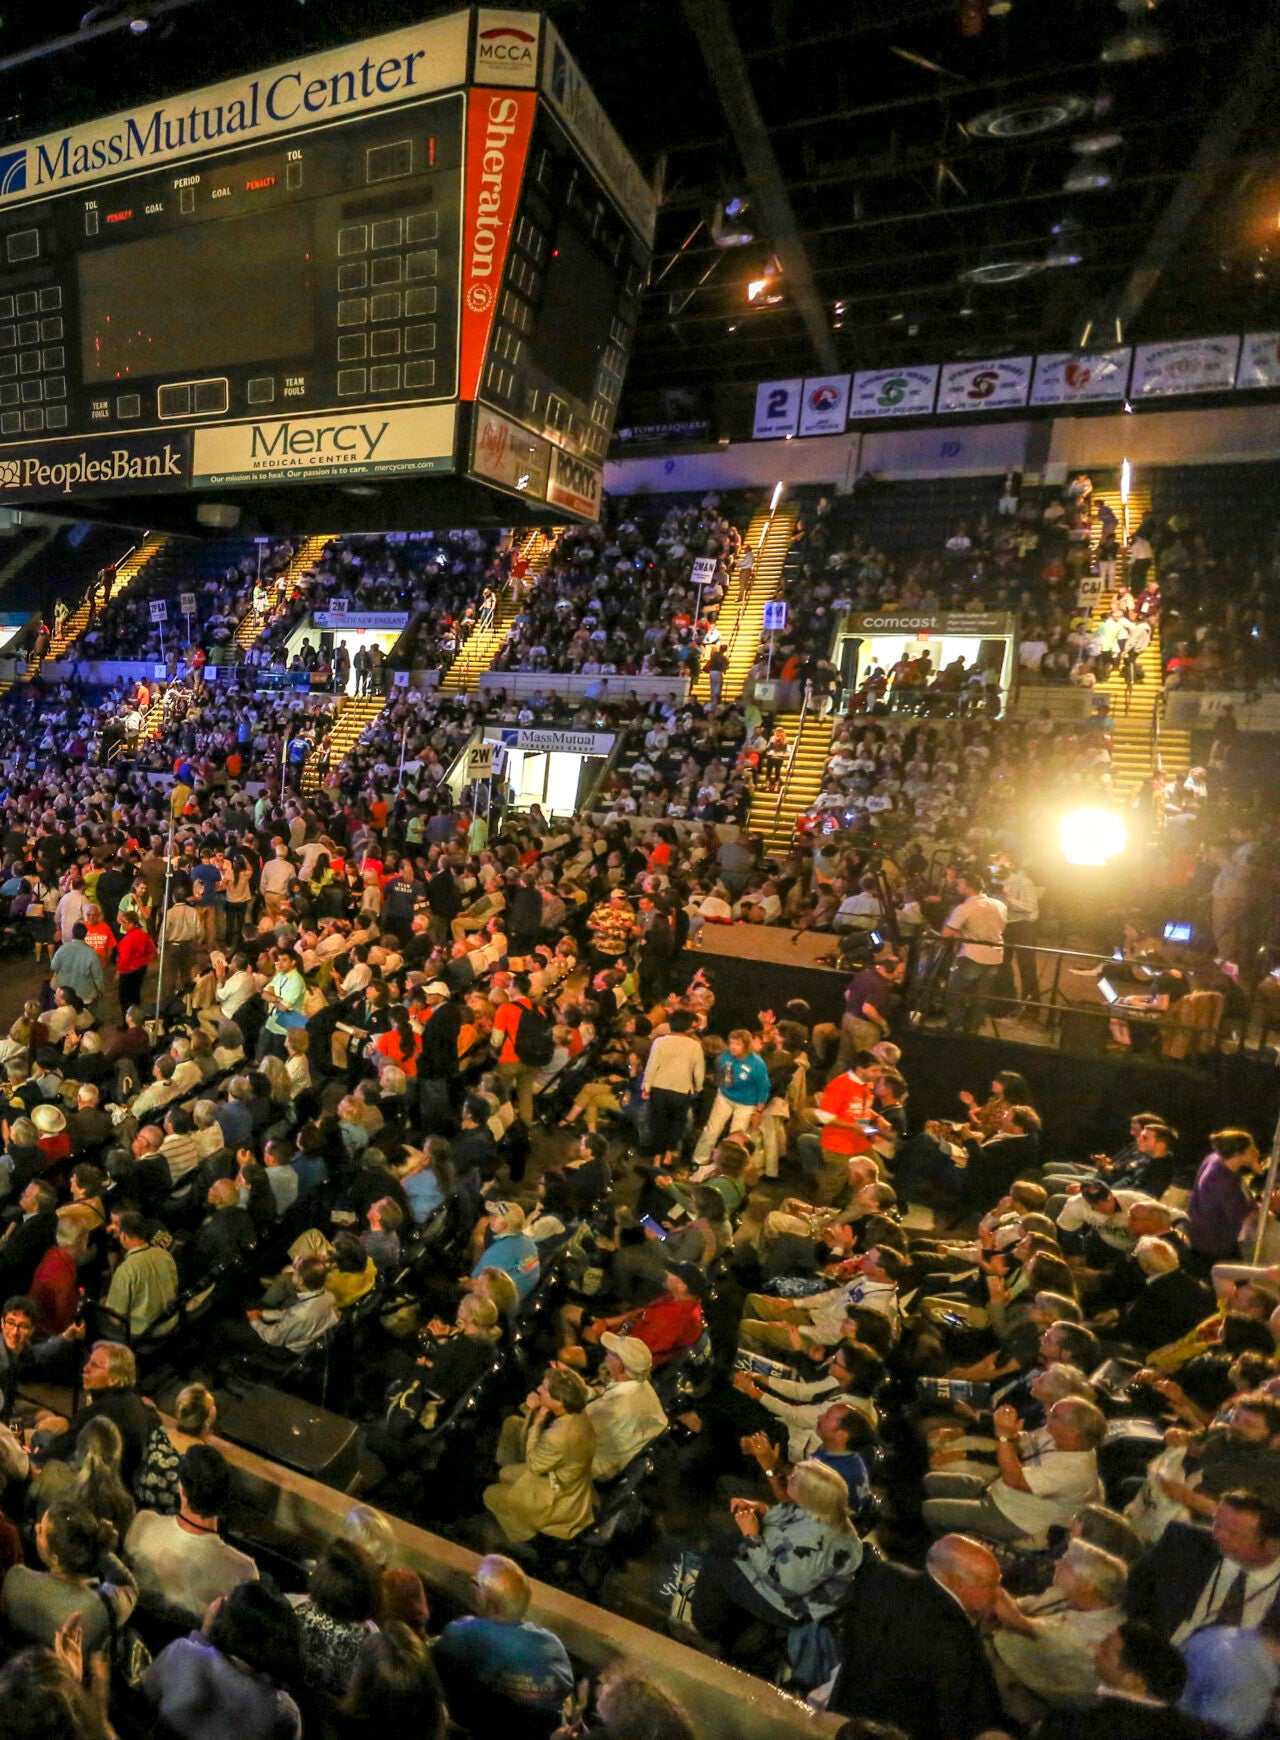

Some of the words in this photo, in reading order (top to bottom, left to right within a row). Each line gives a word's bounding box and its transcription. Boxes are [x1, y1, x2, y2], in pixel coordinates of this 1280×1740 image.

[480, 44, 532, 61] MCCA
[287, 149, 302, 161] TOL
[174, 175, 201, 189] PERIOD
[246, 176, 276, 191] PENALTY
[471, 96, 519, 279] Sheraton
[211, 186, 232, 199] GOAL
[85, 201, 98, 210] TOL
[145, 202, 164, 215] GOAL
[286, 377, 304, 387] TEAM
[284, 386, 305, 397] FOULS
[92, 400, 108, 410] TEAM
[767, 388, 789, 419] 2
[91, 409, 109, 419] FOULS
[251, 422, 390, 460] Mercy
[939, 441, 961, 458] 10
[253, 458, 304, 468] MEDICAL
[309, 453, 358, 465] CENTER
[374, 460, 434, 474] mercycares.com
[664, 460, 676, 474] 9
[23, 444, 182, 493] PeoplesBank
[287, 469, 302, 478] Our
[303, 468, 330, 479] passion
[331, 466, 339, 475] is
[339, 466, 349, 474] to
[349, 465, 369, 474] care.
[210, 475, 225, 484] Our
[225, 472, 251, 482] mission
[251, 472, 259, 480] is
[259, 472, 268, 480] to
[268, 470, 285, 480] heal.
[1082, 581, 1102, 594] C&I
[332, 601, 346, 612] 2M
[863, 617, 938, 629] comcast
[521, 730, 595, 746] MassMutual
[471, 748, 491, 764] 2W
